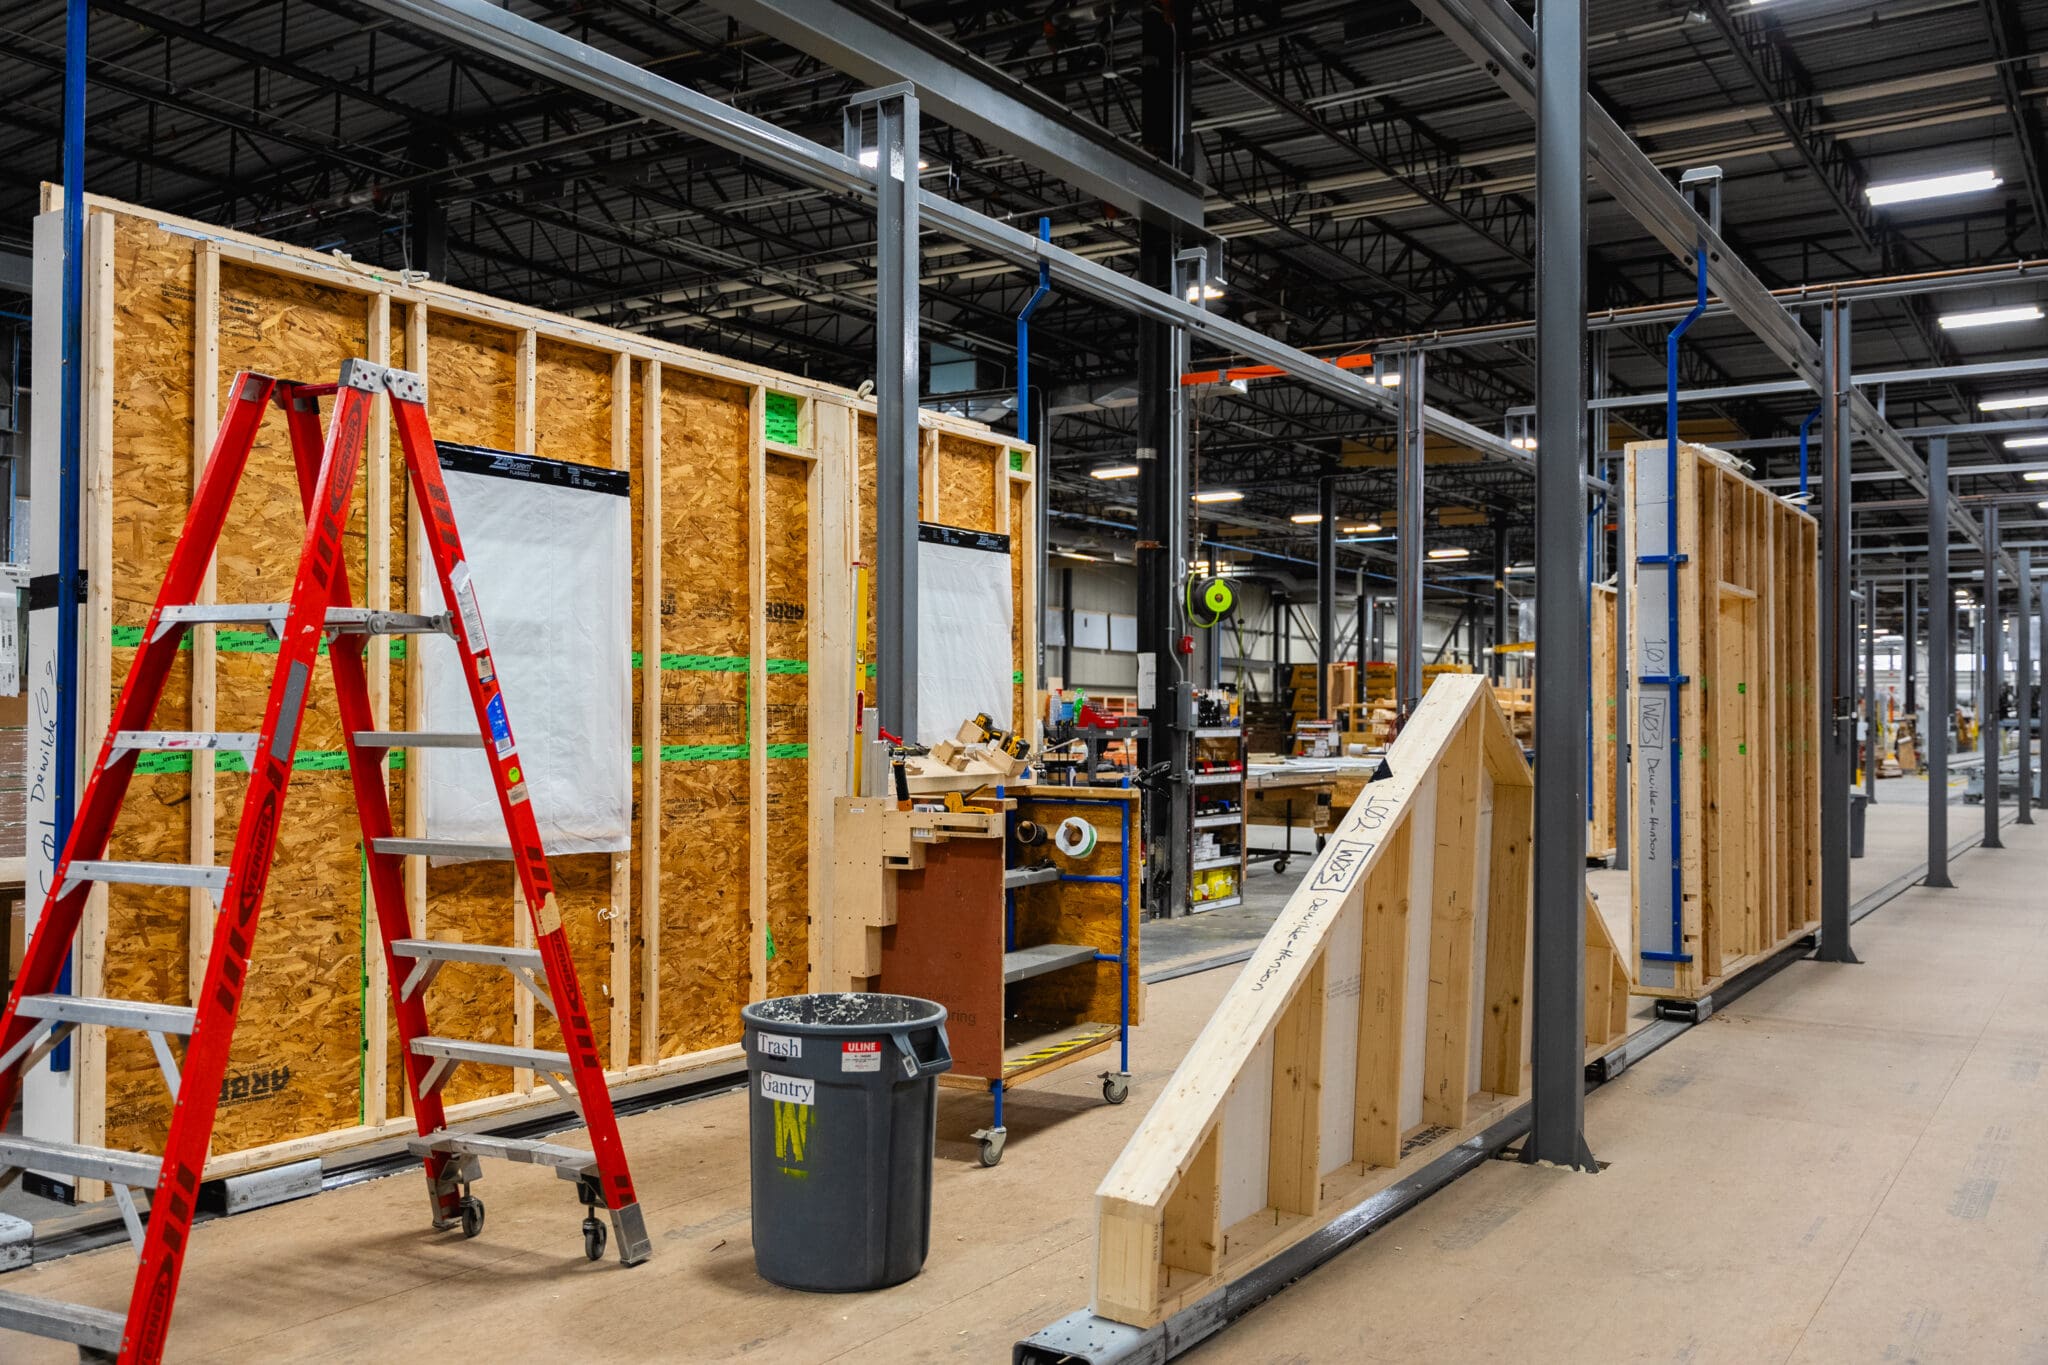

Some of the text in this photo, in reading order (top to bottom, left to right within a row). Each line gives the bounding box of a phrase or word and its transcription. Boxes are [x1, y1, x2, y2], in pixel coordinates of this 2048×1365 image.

[336, 417, 358, 490] WERNER
[30, 719, 58, 803] Dewilde
[246, 812, 273, 896] WERNER
[760, 1033, 799, 1058] Trash
[847, 1042, 877, 1052] ULINE
[762, 1073, 812, 1103] Gantry
[141, 1282, 169, 1365] ERNER
